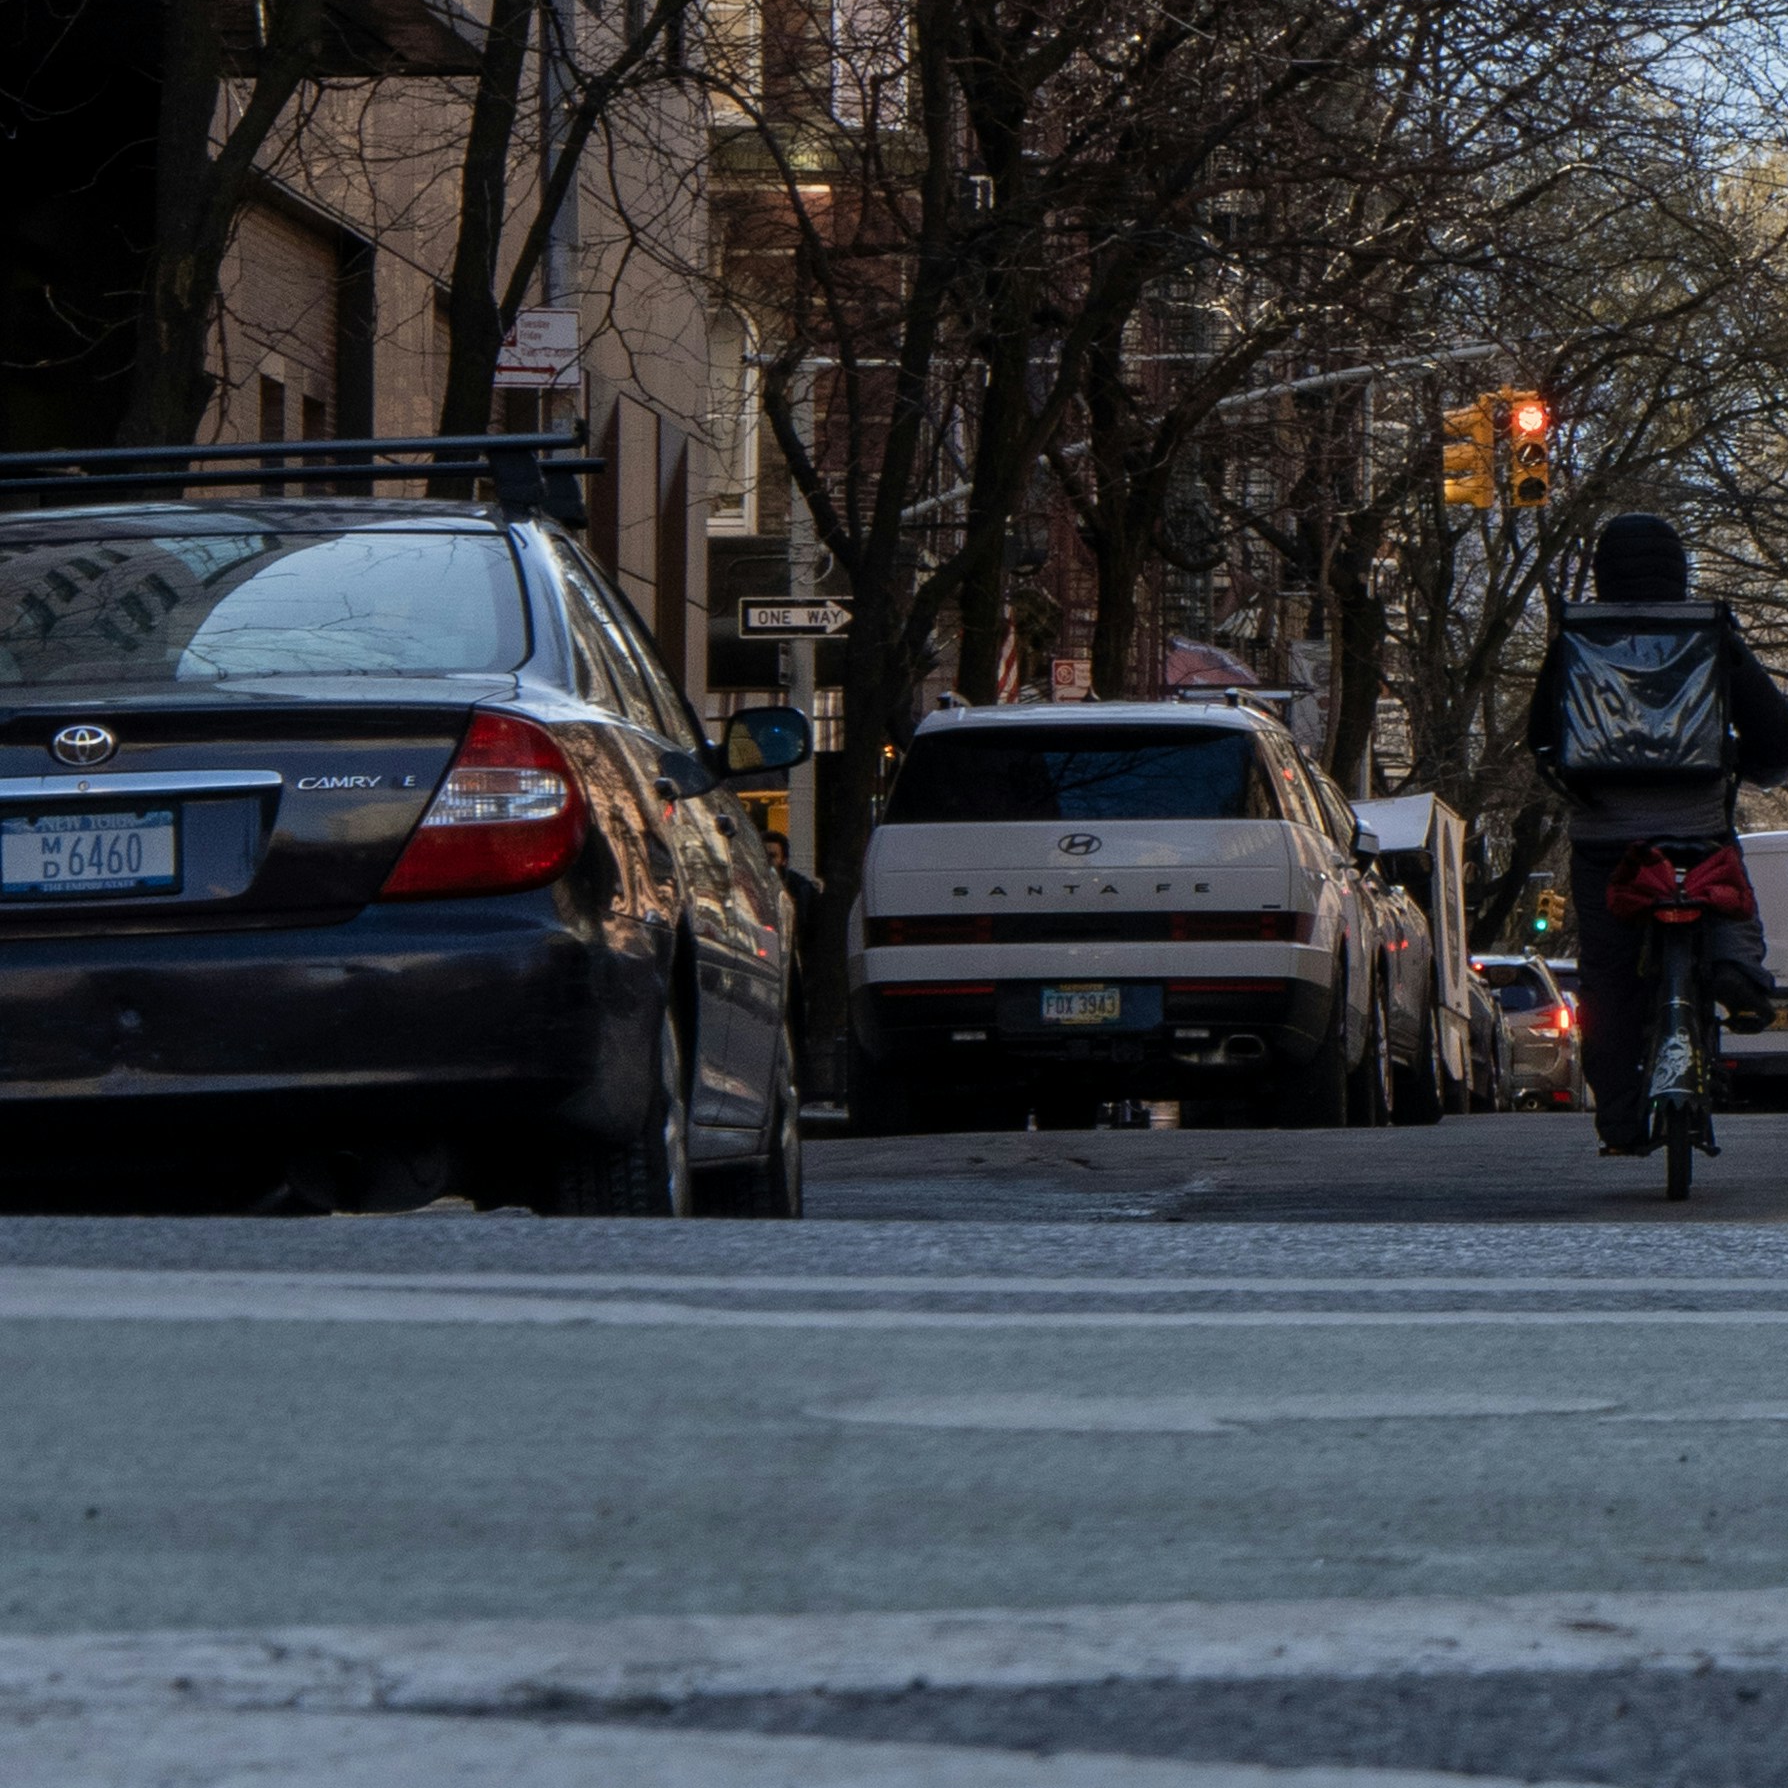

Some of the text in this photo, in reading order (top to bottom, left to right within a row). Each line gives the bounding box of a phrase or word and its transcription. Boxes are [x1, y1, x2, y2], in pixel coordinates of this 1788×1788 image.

[757, 610, 841, 624] ONE WAY
[297, 775, 382, 790] CAMRY
[68, 832, 143, 876] 6460
[953, 883, 1211, 896] SANTA FE
